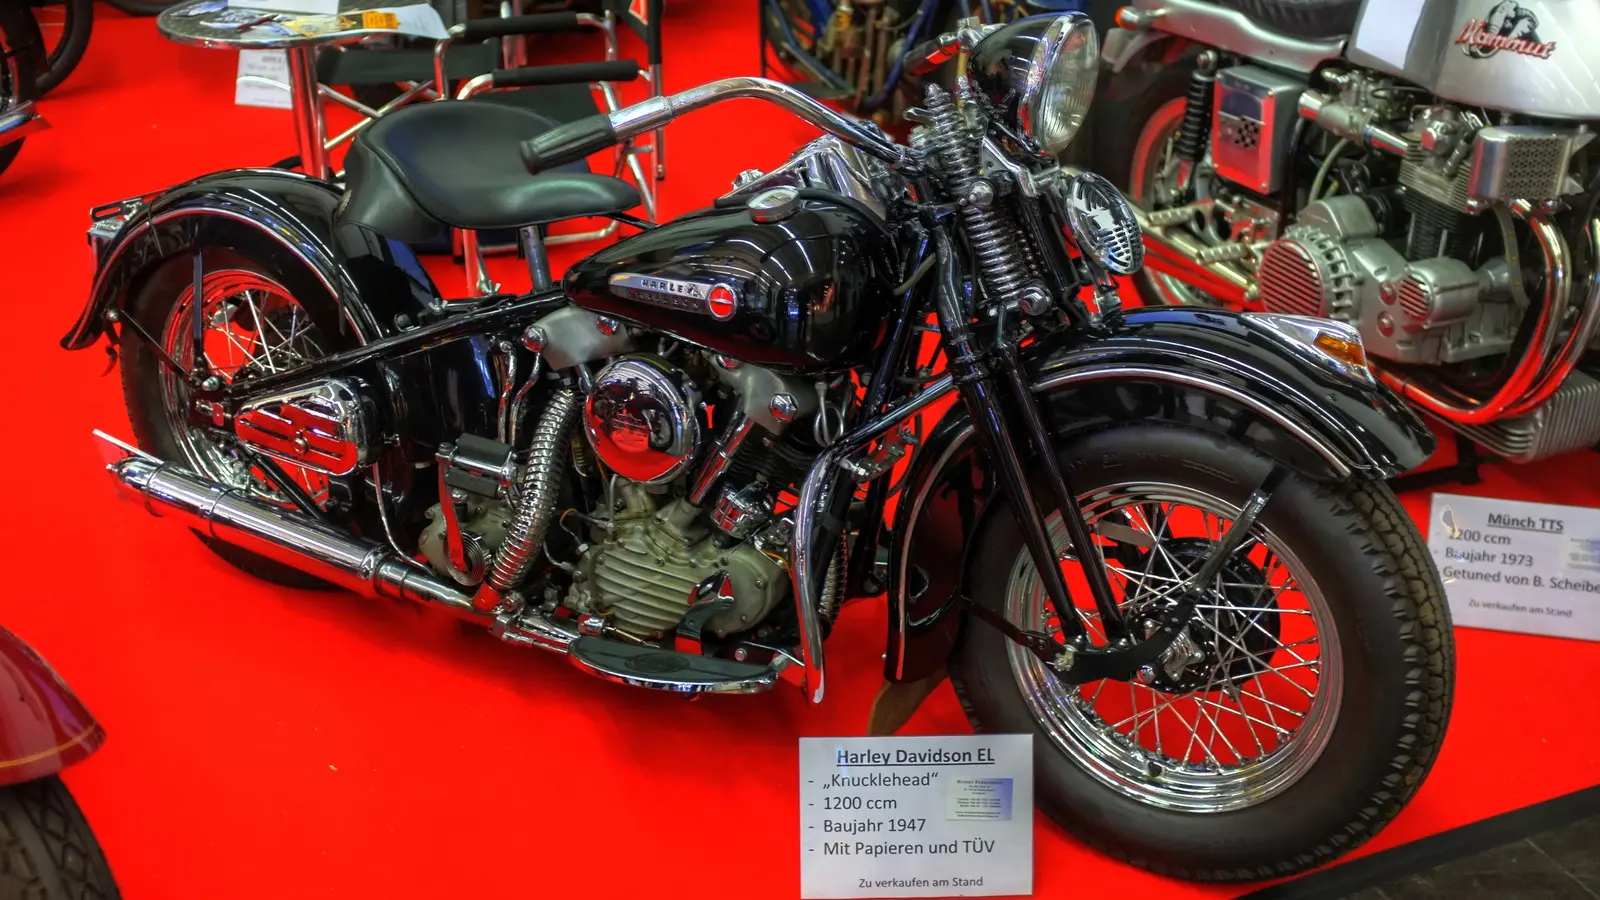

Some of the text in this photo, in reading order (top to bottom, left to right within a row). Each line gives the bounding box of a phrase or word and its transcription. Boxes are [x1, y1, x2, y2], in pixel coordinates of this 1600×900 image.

[1455, 17, 1556, 59] Mammut
[641, 279, 696, 293] HARLEY
[1488, 513, 1564, 531] Münch TTS
[1484, 533, 1511, 545] ccm
[1445, 547, 1534, 567] Baujahr 1973
[1443, 566, 1500, 583] Getuned
[1504, 574, 1529, 585] von
[1533, 576, 1545, 588] B.
[1468, 598, 1572, 617] Zu verkaufen am Stand
[837, 748, 995, 766] Harley Davidson EL
[823, 796, 897, 810] 1200 ccm
[824, 818, 926, 835] Baujahr 1947
[824, 837, 995, 857] Mit Papieren und TÜV
[858, 876, 983, 888] Zu verkaufen am Stand
